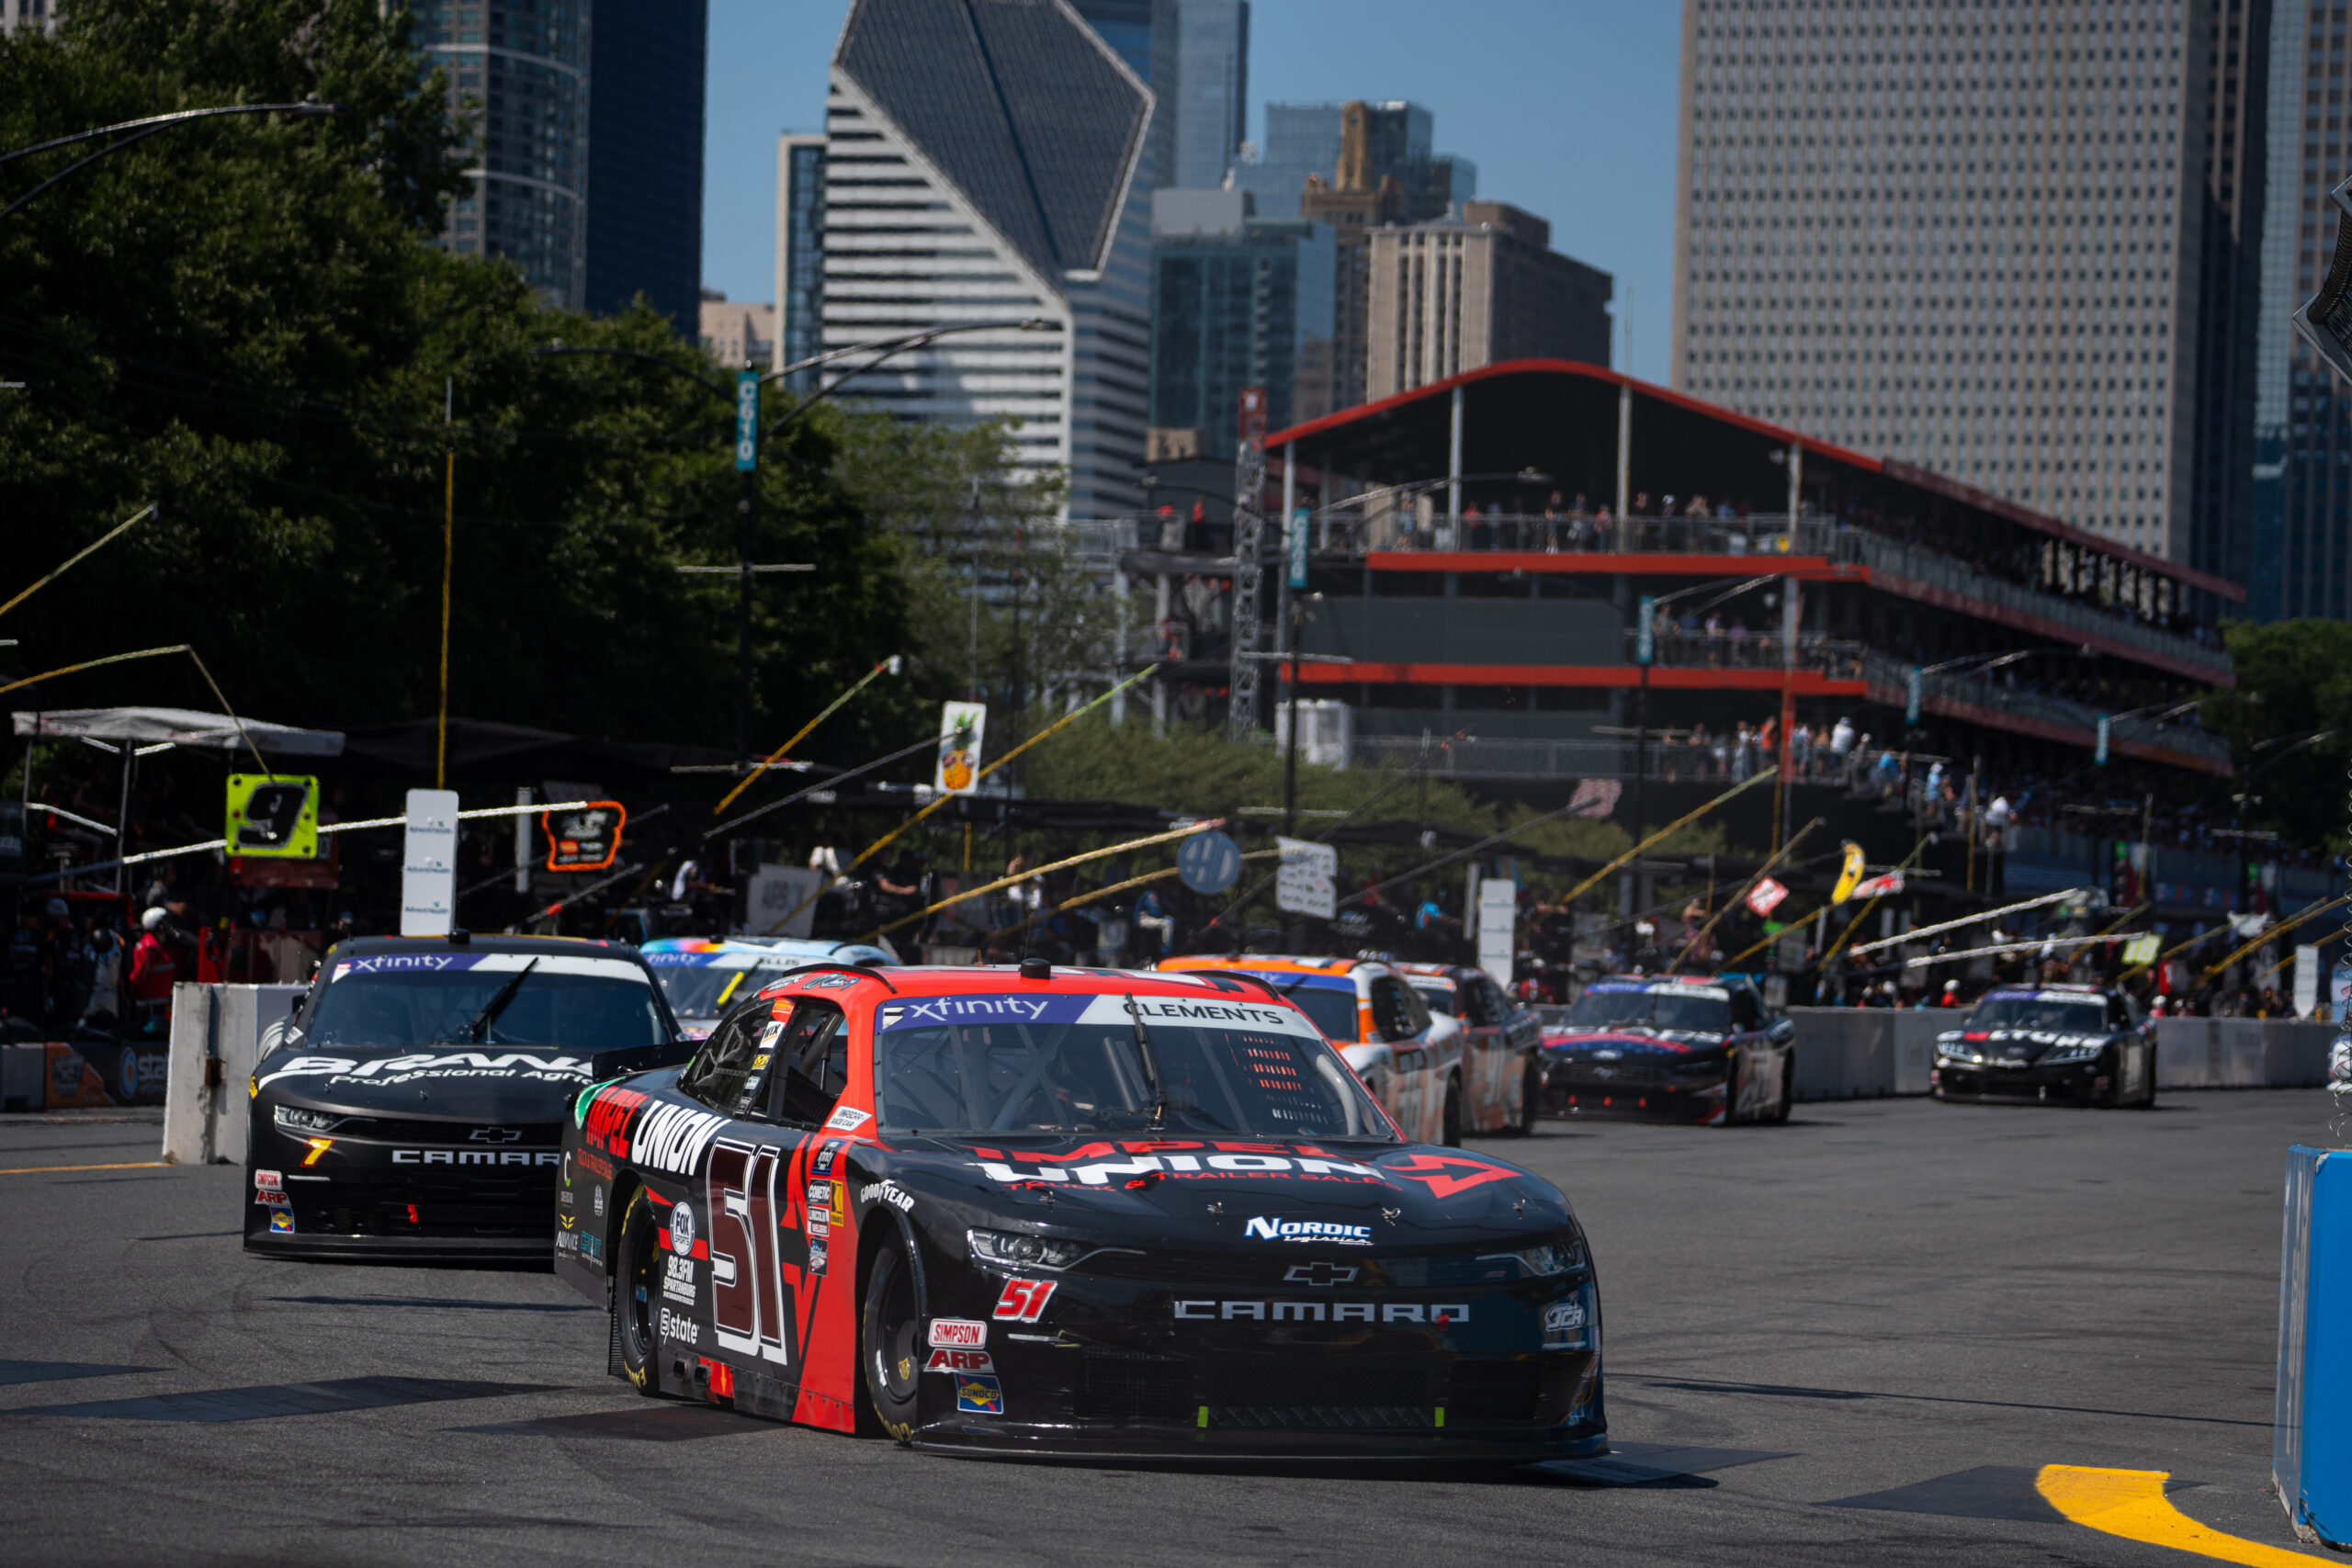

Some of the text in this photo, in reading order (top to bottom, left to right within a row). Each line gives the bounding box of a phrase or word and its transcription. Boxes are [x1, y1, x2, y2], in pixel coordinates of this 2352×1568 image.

[236, 782, 309, 850] 9
[356, 955, 454, 972] xfinity
[910, 996, 1048, 1021] xfinity
[1124, 1002, 1283, 1024] CLEMENTS
[330, 1068, 516, 1086] Professional
[631, 1100, 733, 1176] UNION
[300, 1137, 336, 1168] 7
[956, 1141, 1371, 1166] IMPEL
[963, 1155, 1385, 1185] UNION
[1002, 1172, 1403, 1192] TRUCK & TRAILER SALES
[257, 1190, 288, 1203] ARP
[675, 1212, 689, 1236] FOX
[674, 1234, 690, 1247] SPORTS
[707, 1136, 787, 1366] 51
[667, 1255, 695, 1283] 98.3FM
[992, 1277, 1059, 1323] 51
[1174, 1300, 1470, 1323] CAMARO
[670, 1313, 699, 1345] state
[933, 1323, 981, 1345] SIMPSON
[928, 1349, 990, 1370] ARP
[960, 1387, 999, 1400] SUNOCO
